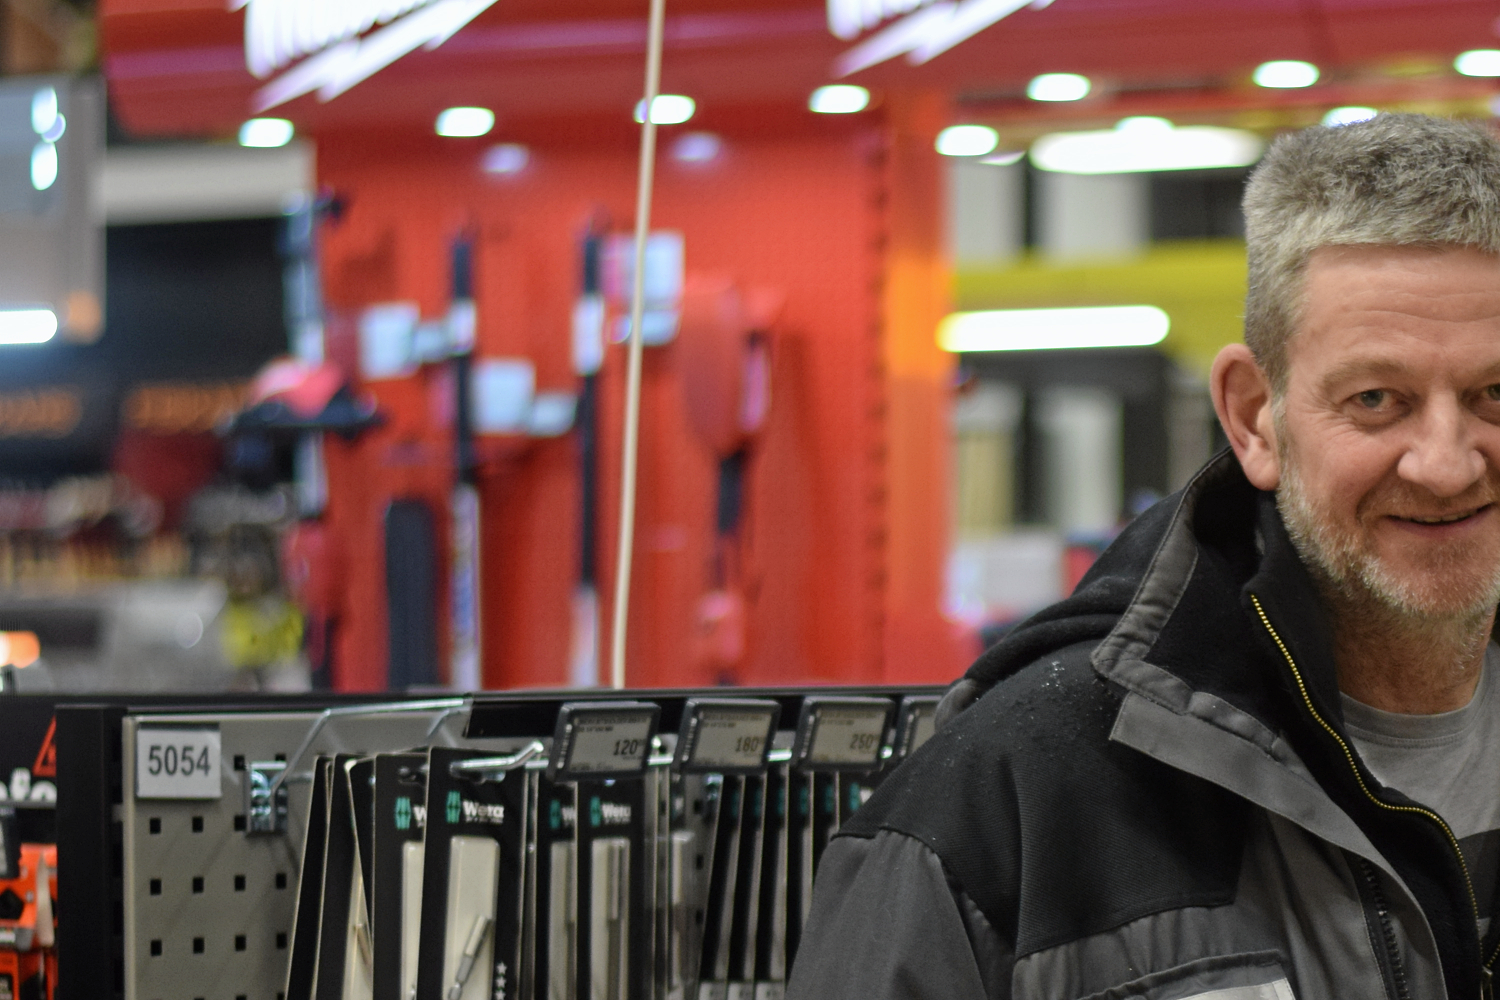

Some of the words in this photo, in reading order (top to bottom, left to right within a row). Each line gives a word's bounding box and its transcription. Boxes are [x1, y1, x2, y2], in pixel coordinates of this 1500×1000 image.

[613, 739, 639, 756] 120
[148, 744, 211, 777] 5054
[463, 801, 505, 819] Wera
